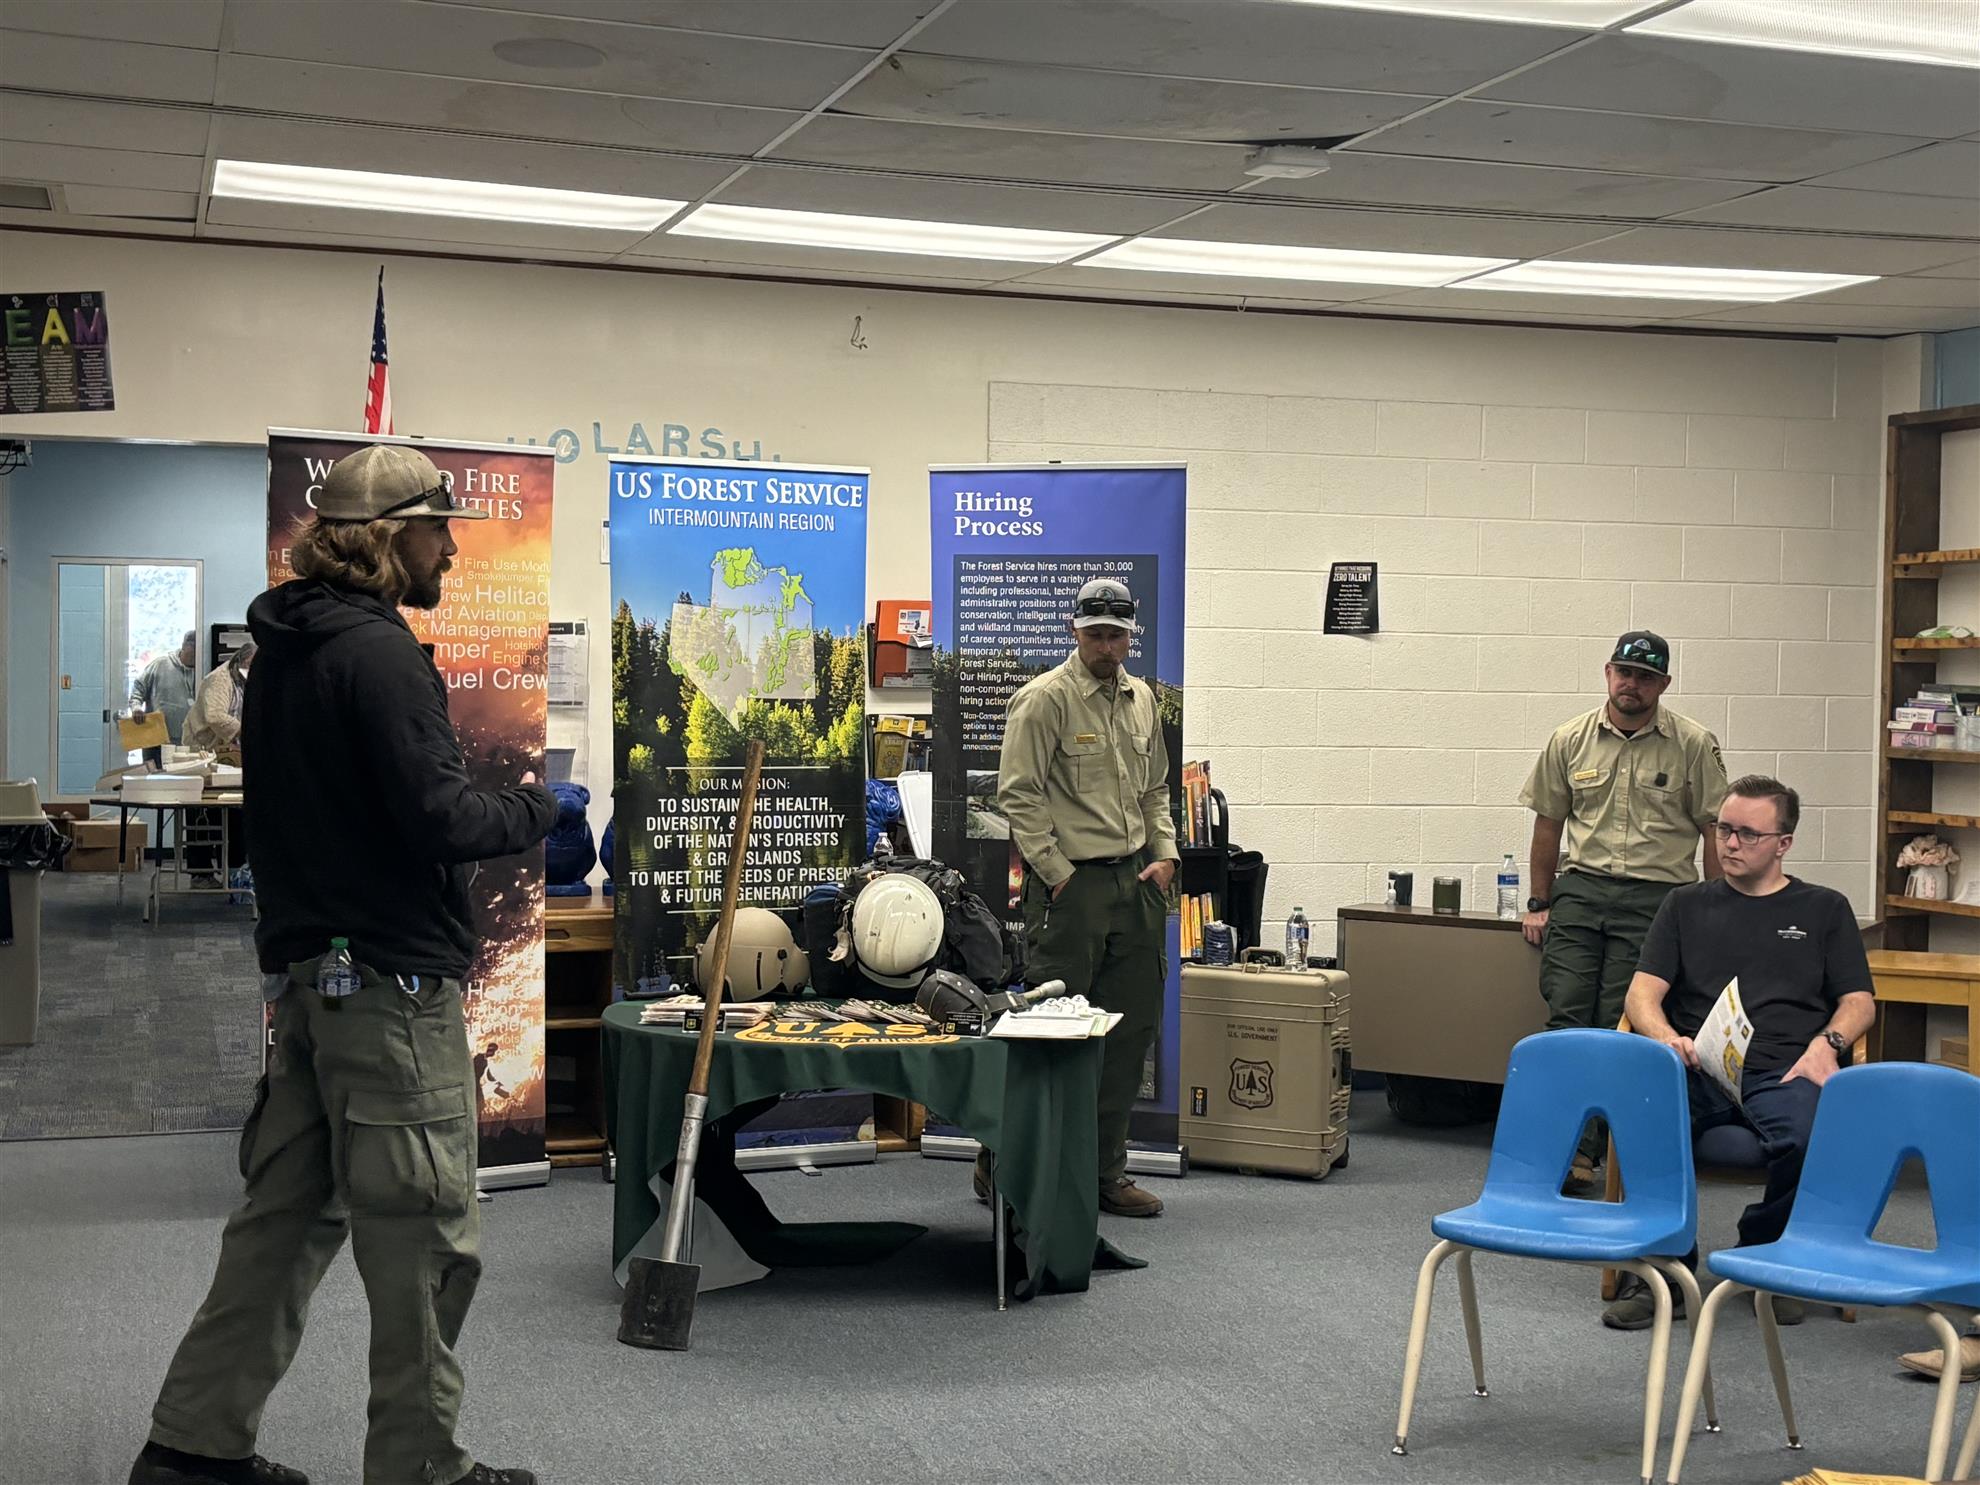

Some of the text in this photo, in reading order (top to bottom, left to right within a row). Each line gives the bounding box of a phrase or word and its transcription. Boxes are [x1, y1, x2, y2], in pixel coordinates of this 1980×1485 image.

[464, 468, 520, 494] FIRE
[615, 472, 863, 508] US FOREST SERVICE
[954, 492, 1033, 517] Hiring
[649, 508, 835, 532] INTERMOUNTAIN REGION
[954, 516, 1043, 536] Process
[464, 557, 489, 569] Fire
[493, 559, 518, 571] Use
[960, 561, 1134, 572] The Forest Service hires more than 30,000
[960, 574, 1004, 584] employees
[1006, 574, 1015, 583] to
[1016, 575, 1039, 583] serve
[1040, 574, 1049, 583] in
[1057, 574, 1085, 585] variety
[1348, 573, 1371, 582] TALENT
[960, 586, 1079, 597] including professional, techni
[960, 598, 1017, 608] administrative
[1020, 599, 1057, 609] positions
[457, 606, 526, 622] Aviation
[960, 611, 1015, 620] conservation,
[430, 620, 542, 641] Management
[960, 623, 1069, 634] and wildland management.
[960, 635, 968, 643] of
[970, 635, 996, 643] career
[998, 635, 1052, 645] opportunities
[493, 651, 541, 667] Engine
[960, 647, 1004, 657] temporary,
[1005, 648, 1021, 656] and
[1023, 648, 1067, 657] permanent
[960, 659, 985, 668] Forest
[493, 668, 548, 690] Crew
[960, 671, 975, 681] Our
[977, 672, 1001, 683] Hiring
[960, 696, 983, 706] hiring
[963, 722, 987, 730] options
[699, 777, 790, 791] OUR MSION:
[657, 797, 833, 813] TO SUSTAIN HE HEALTH,
[646, 814, 845, 832] DIVERSITY, & RODUCTIVITY
[654, 832, 839, 849] OF THE NATN'S FORESTS
[693, 850, 802, 866] & GRSLANDS
[629, 871, 649, 886] TO
[654, 870, 691, 885] MEET
[696, 869, 723, 884] THE
[740, 868, 772, 883] EEDS
[777, 868, 795, 882] OF
[660, 886, 815, 903] & FUTUR GENERATIO
[1241, 1032, 1278, 1041] GOVERNMENT
[1236, 1073, 1268, 1094] U S
